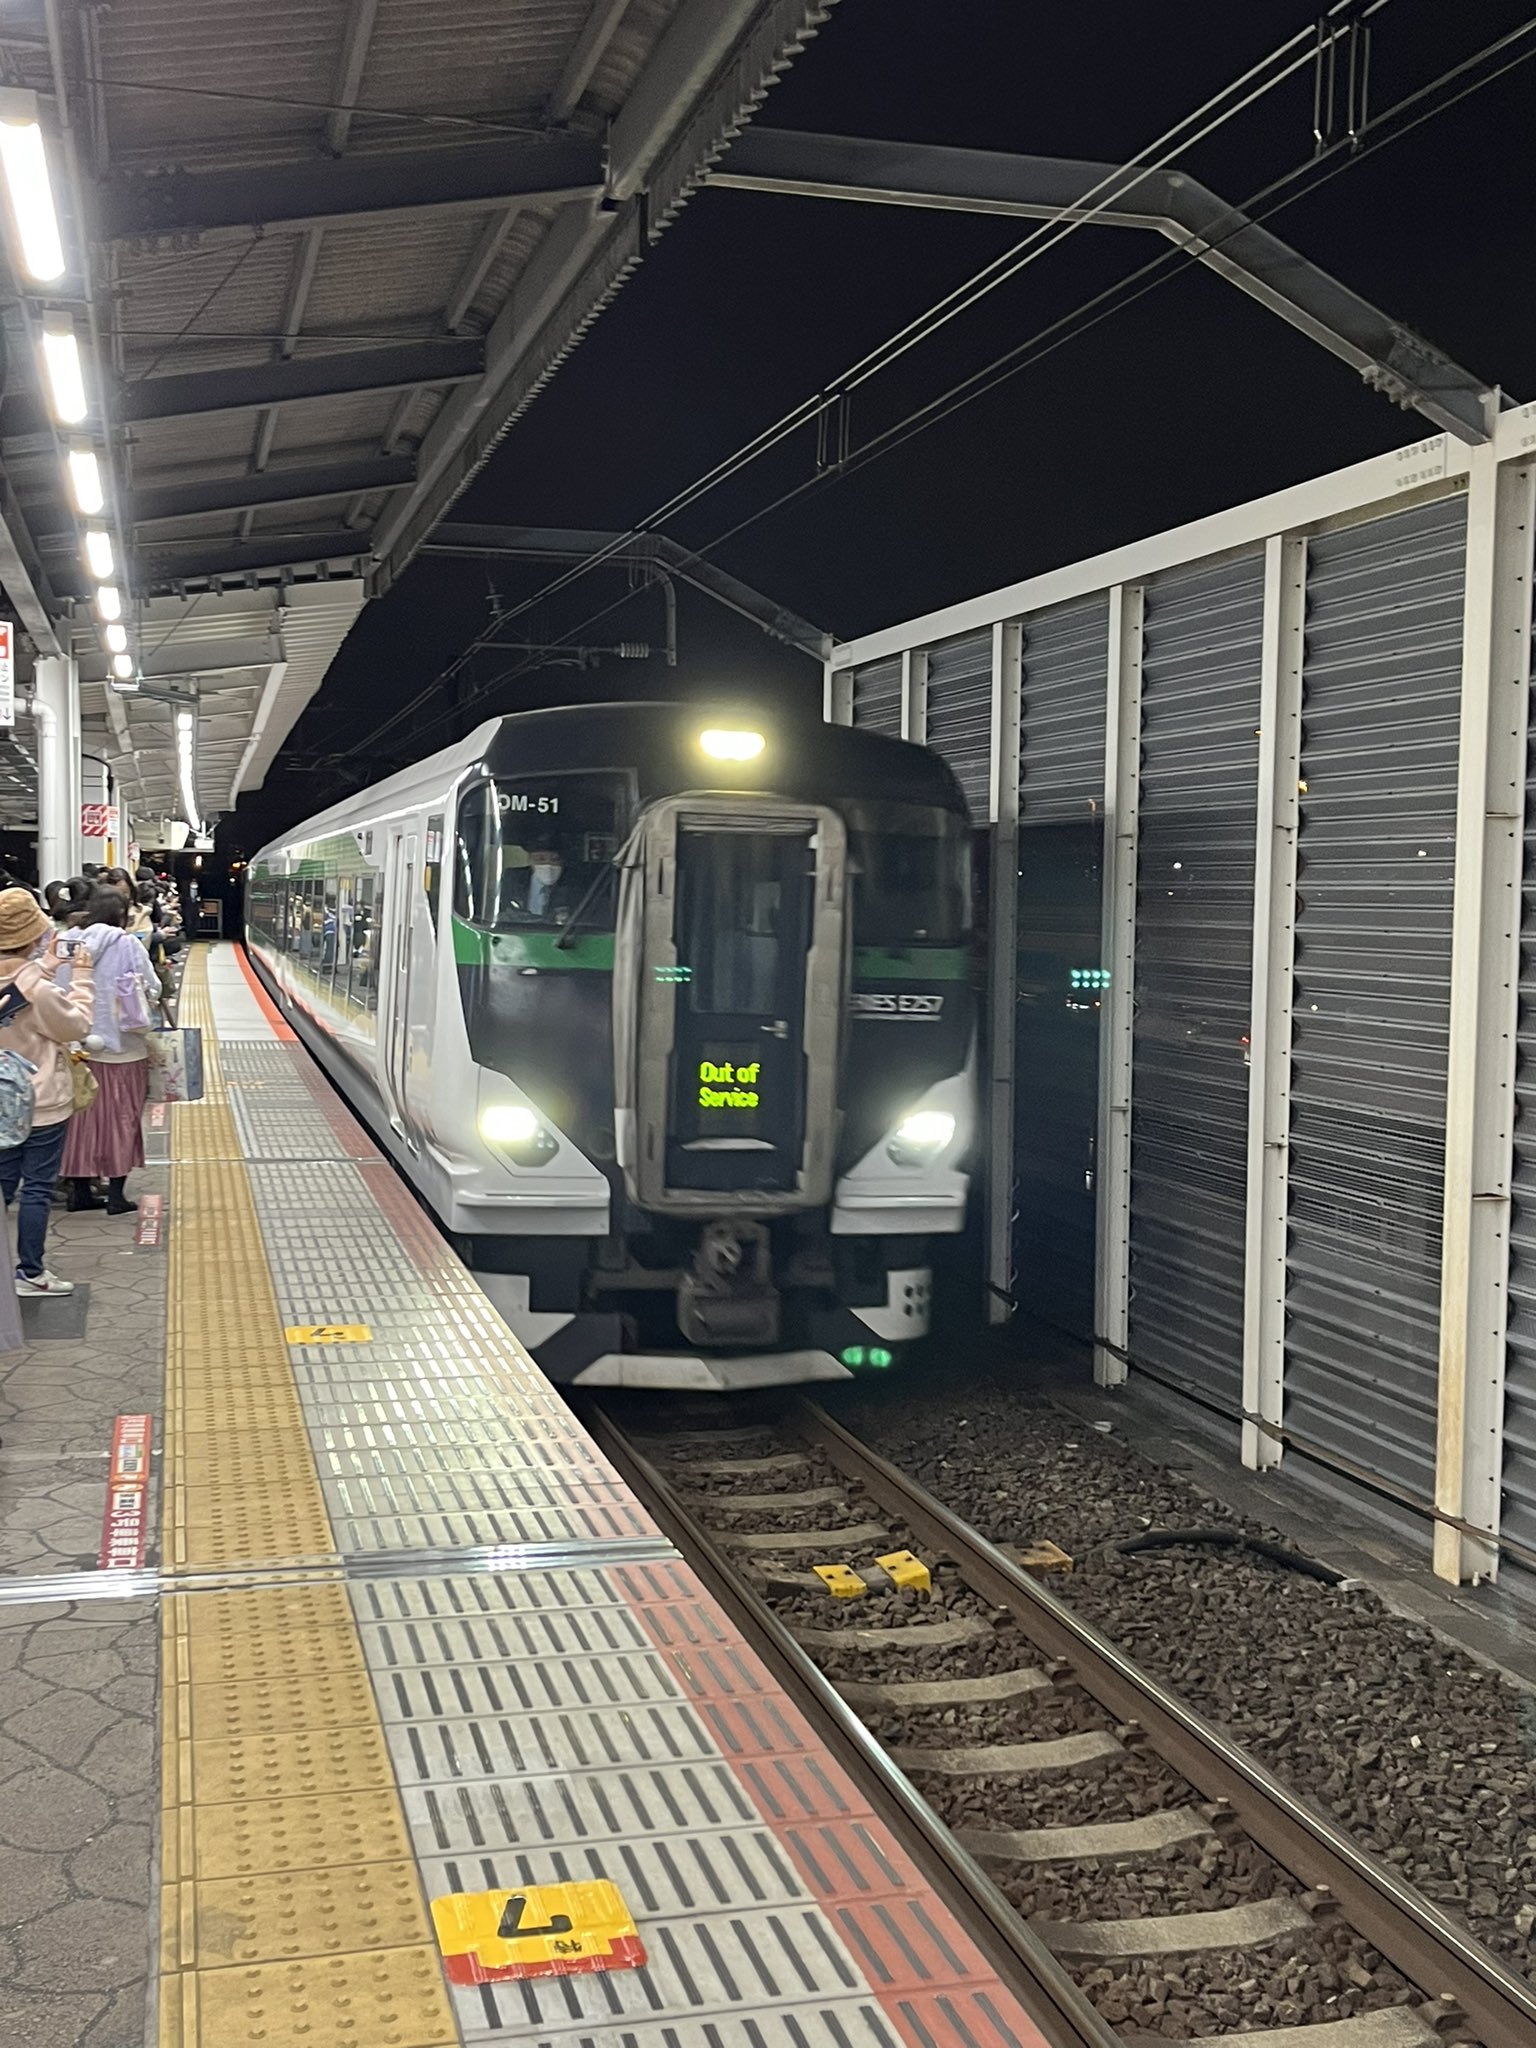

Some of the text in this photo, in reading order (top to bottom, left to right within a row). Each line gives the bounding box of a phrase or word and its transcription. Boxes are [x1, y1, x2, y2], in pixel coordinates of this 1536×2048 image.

[700, 1061, 761, 1083] Out of
[698, 1087, 759, 1108] Service
[497, 1894, 573, 1939] 7
